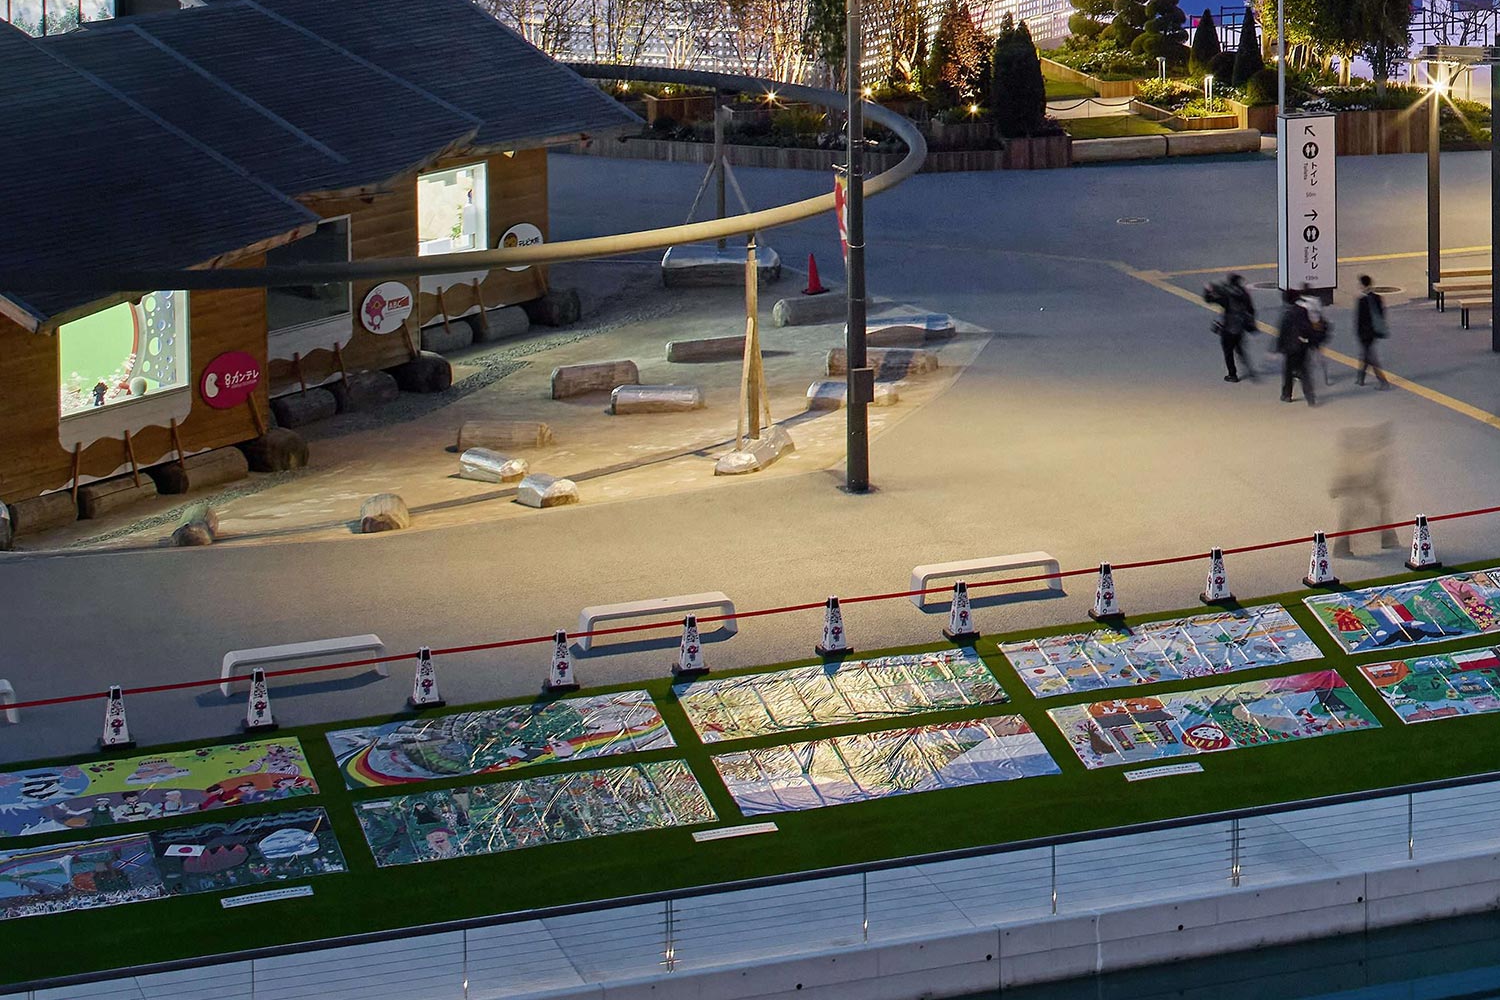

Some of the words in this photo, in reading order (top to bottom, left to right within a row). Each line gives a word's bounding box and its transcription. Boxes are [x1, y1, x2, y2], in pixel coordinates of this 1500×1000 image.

[1310, 161, 1318, 186] トイレ
[1311, 245, 1319, 270] トイレ
